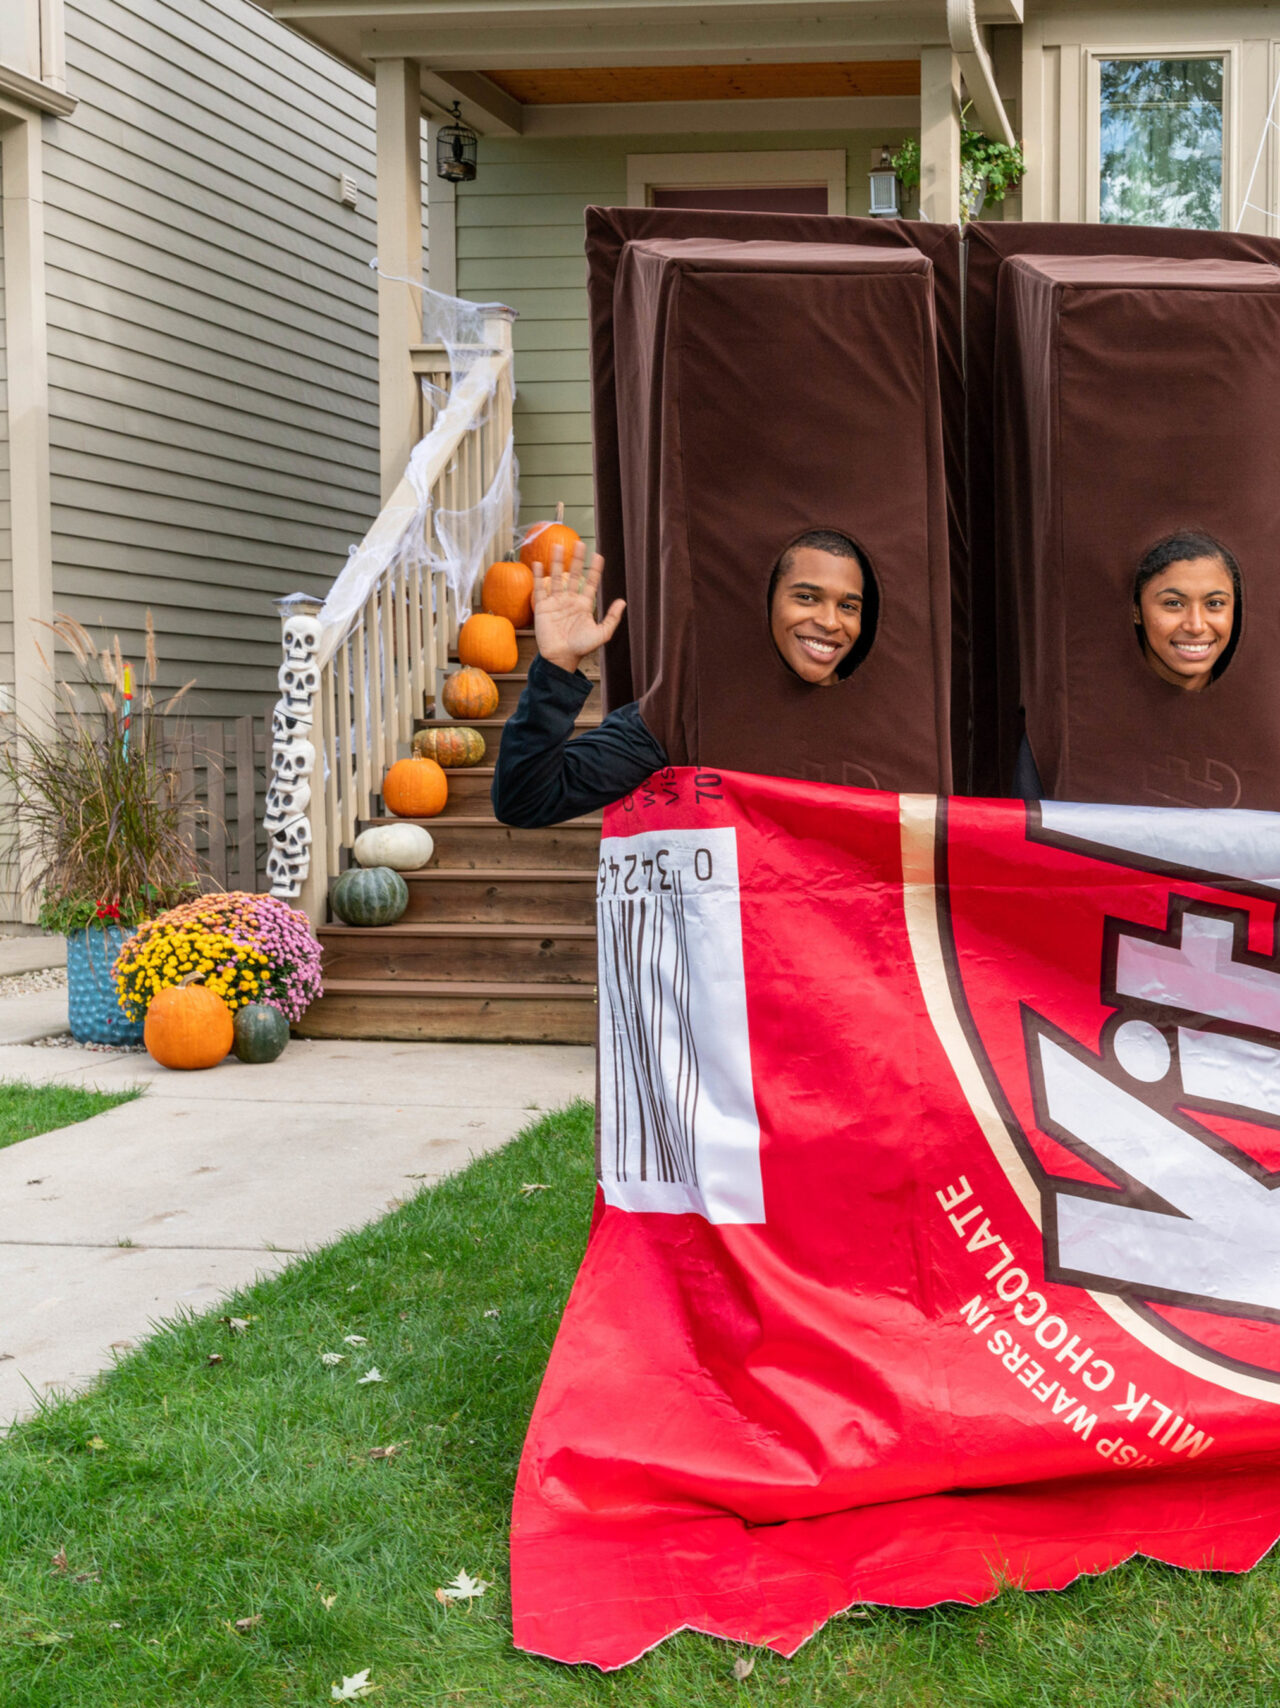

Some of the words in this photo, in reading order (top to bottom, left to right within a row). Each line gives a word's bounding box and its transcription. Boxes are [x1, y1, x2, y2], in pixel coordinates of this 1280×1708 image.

[694, 767, 723, 804] 70
[695, 849, 712, 881] 0
[935, 1175, 1115, 1392] CHOCOLATE
[959, 1295, 995, 1334] IN
[986, 1329, 1099, 1441] WAFERS
[1112, 1382, 1215, 1459] MILK
